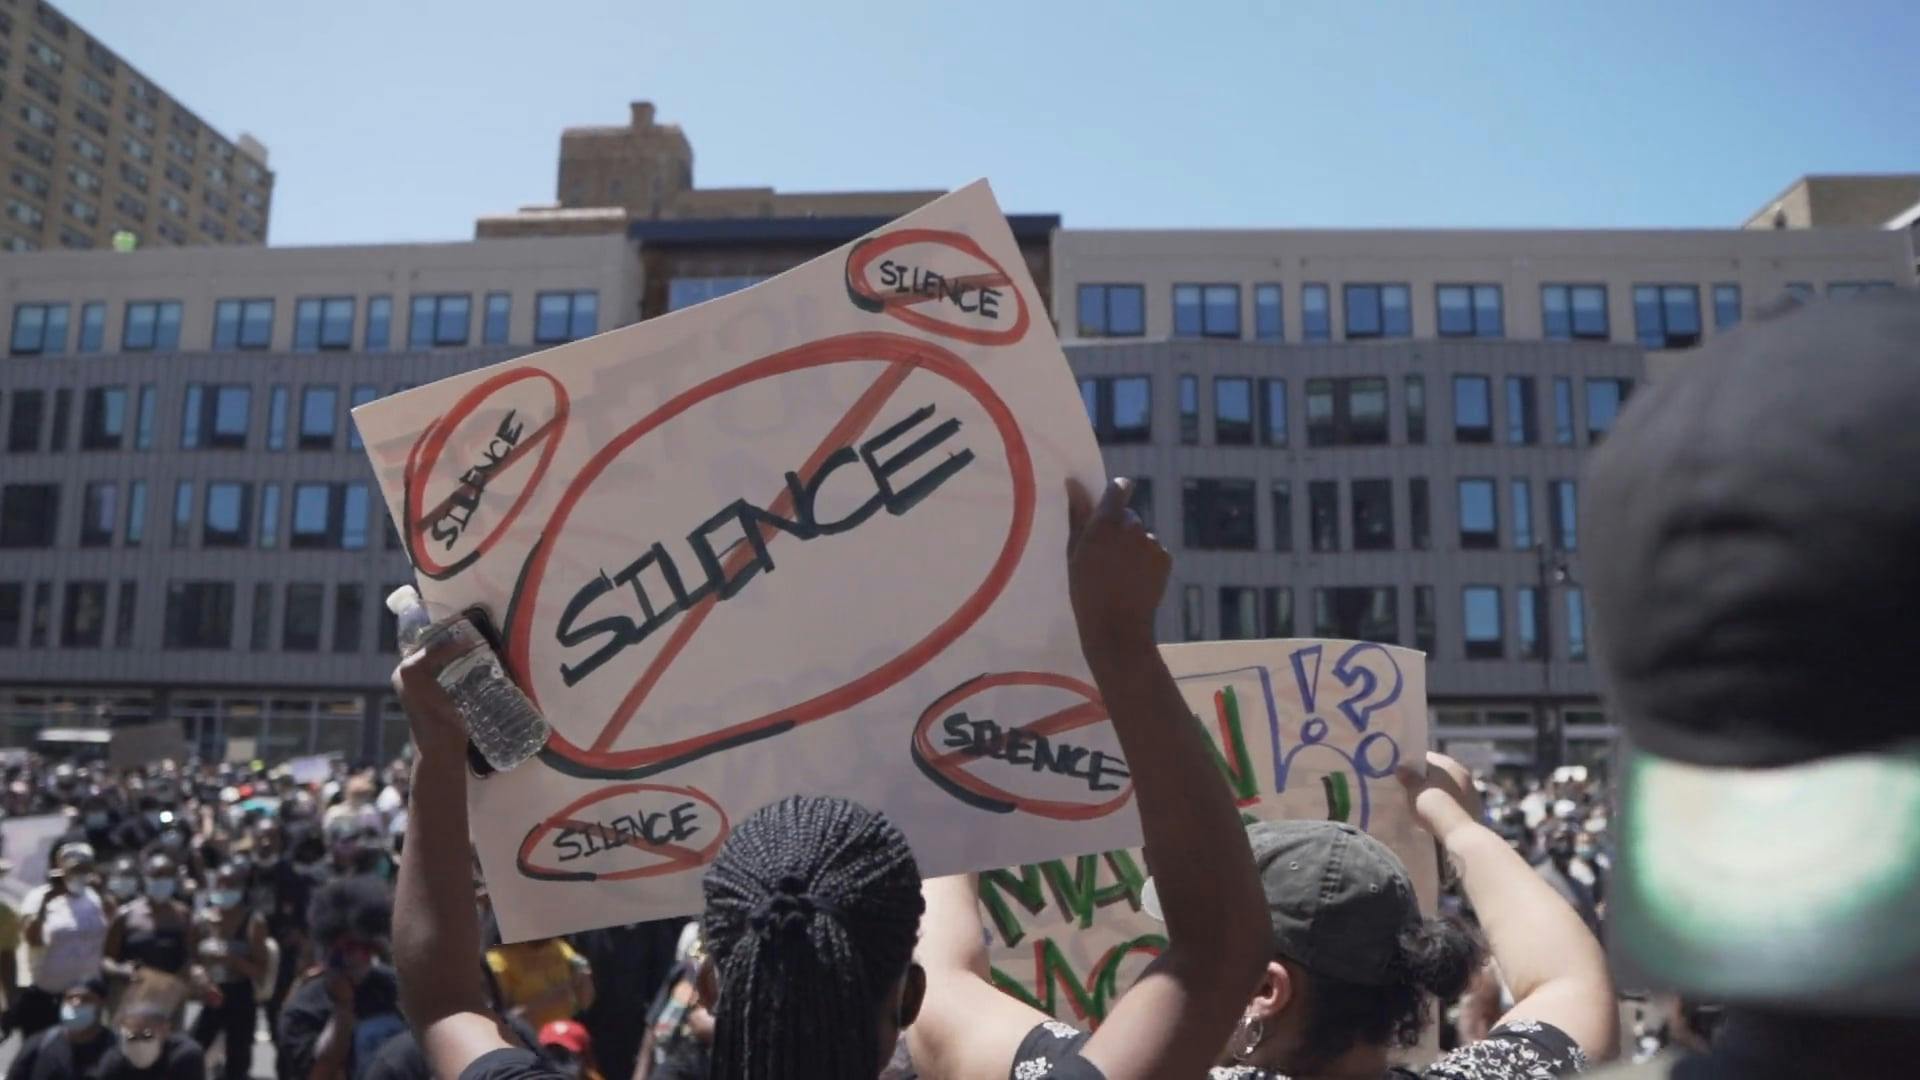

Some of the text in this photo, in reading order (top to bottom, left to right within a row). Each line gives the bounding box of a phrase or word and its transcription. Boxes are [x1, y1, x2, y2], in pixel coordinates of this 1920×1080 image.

[880, 260, 1003, 320] SILENCE
[431, 408, 524, 551] SILENCE
[556, 402, 976, 687] SILENCE
[942, 711, 1131, 792] SILENCE
[553, 801, 701, 862] SILENCE
